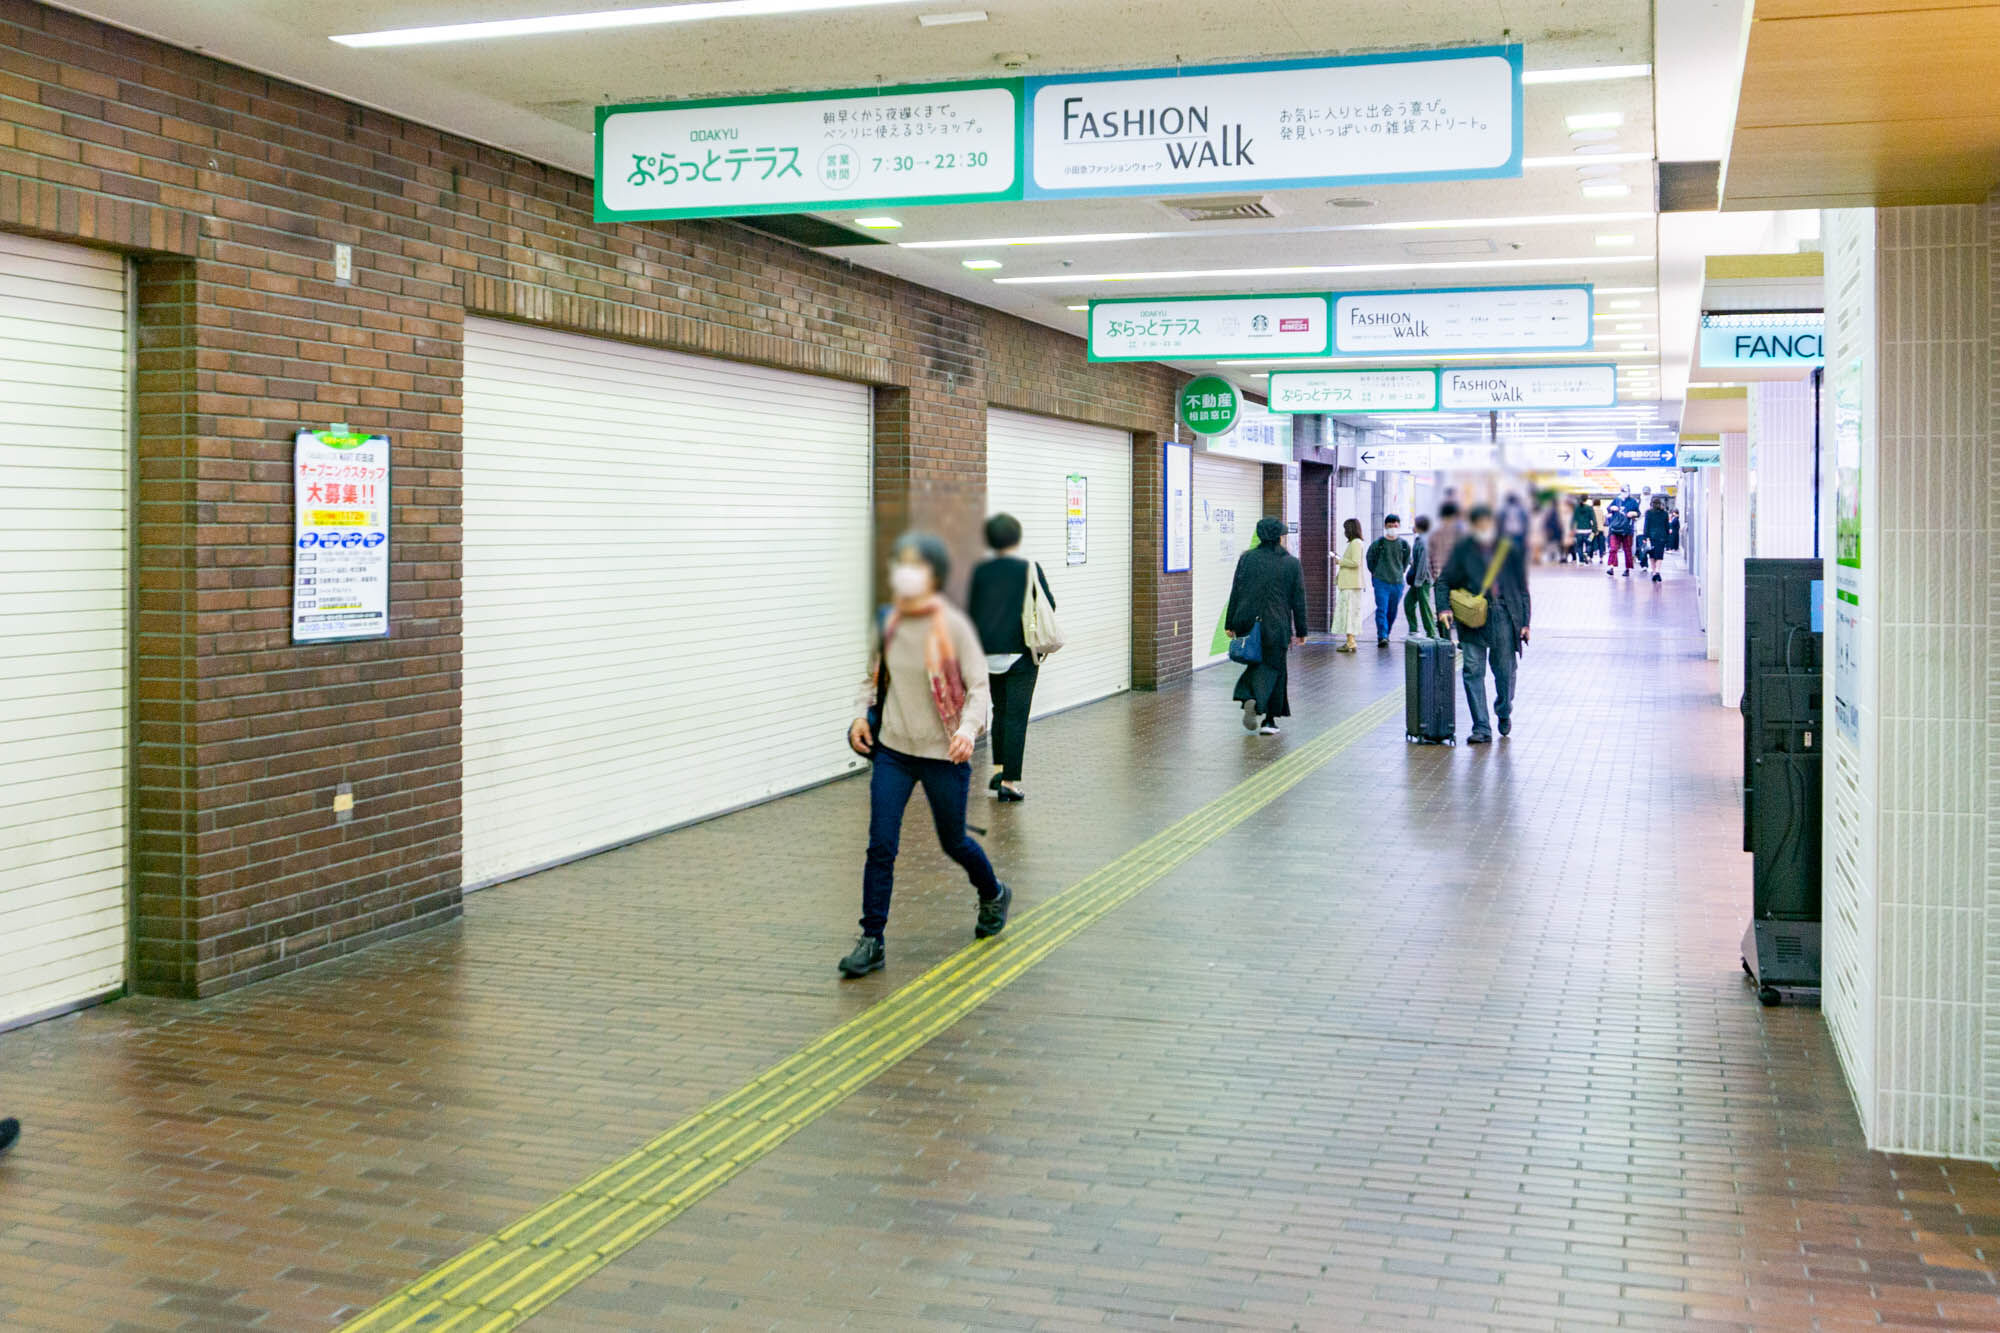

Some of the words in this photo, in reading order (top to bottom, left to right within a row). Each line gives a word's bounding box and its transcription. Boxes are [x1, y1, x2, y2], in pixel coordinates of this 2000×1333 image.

[823, 104, 957, 124] 朝早くから夜遅くまで。
[1279, 98, 1447, 124] お気に入りと出会う喜び。
[690, 128, 739, 142] ODAKYU
[1279, 116, 1488, 141] 発見いっぱいの雑貨ストリート。
[627, 147, 803, 186] ぷらっとテラス
[1106, 319, 1201, 337] ぷらっとテラス
[1186, 392, 1233, 409] 不動産
[1189, 410, 1231, 422] 相談窓口
[299, 462, 386, 480] オープニングスタッフ
